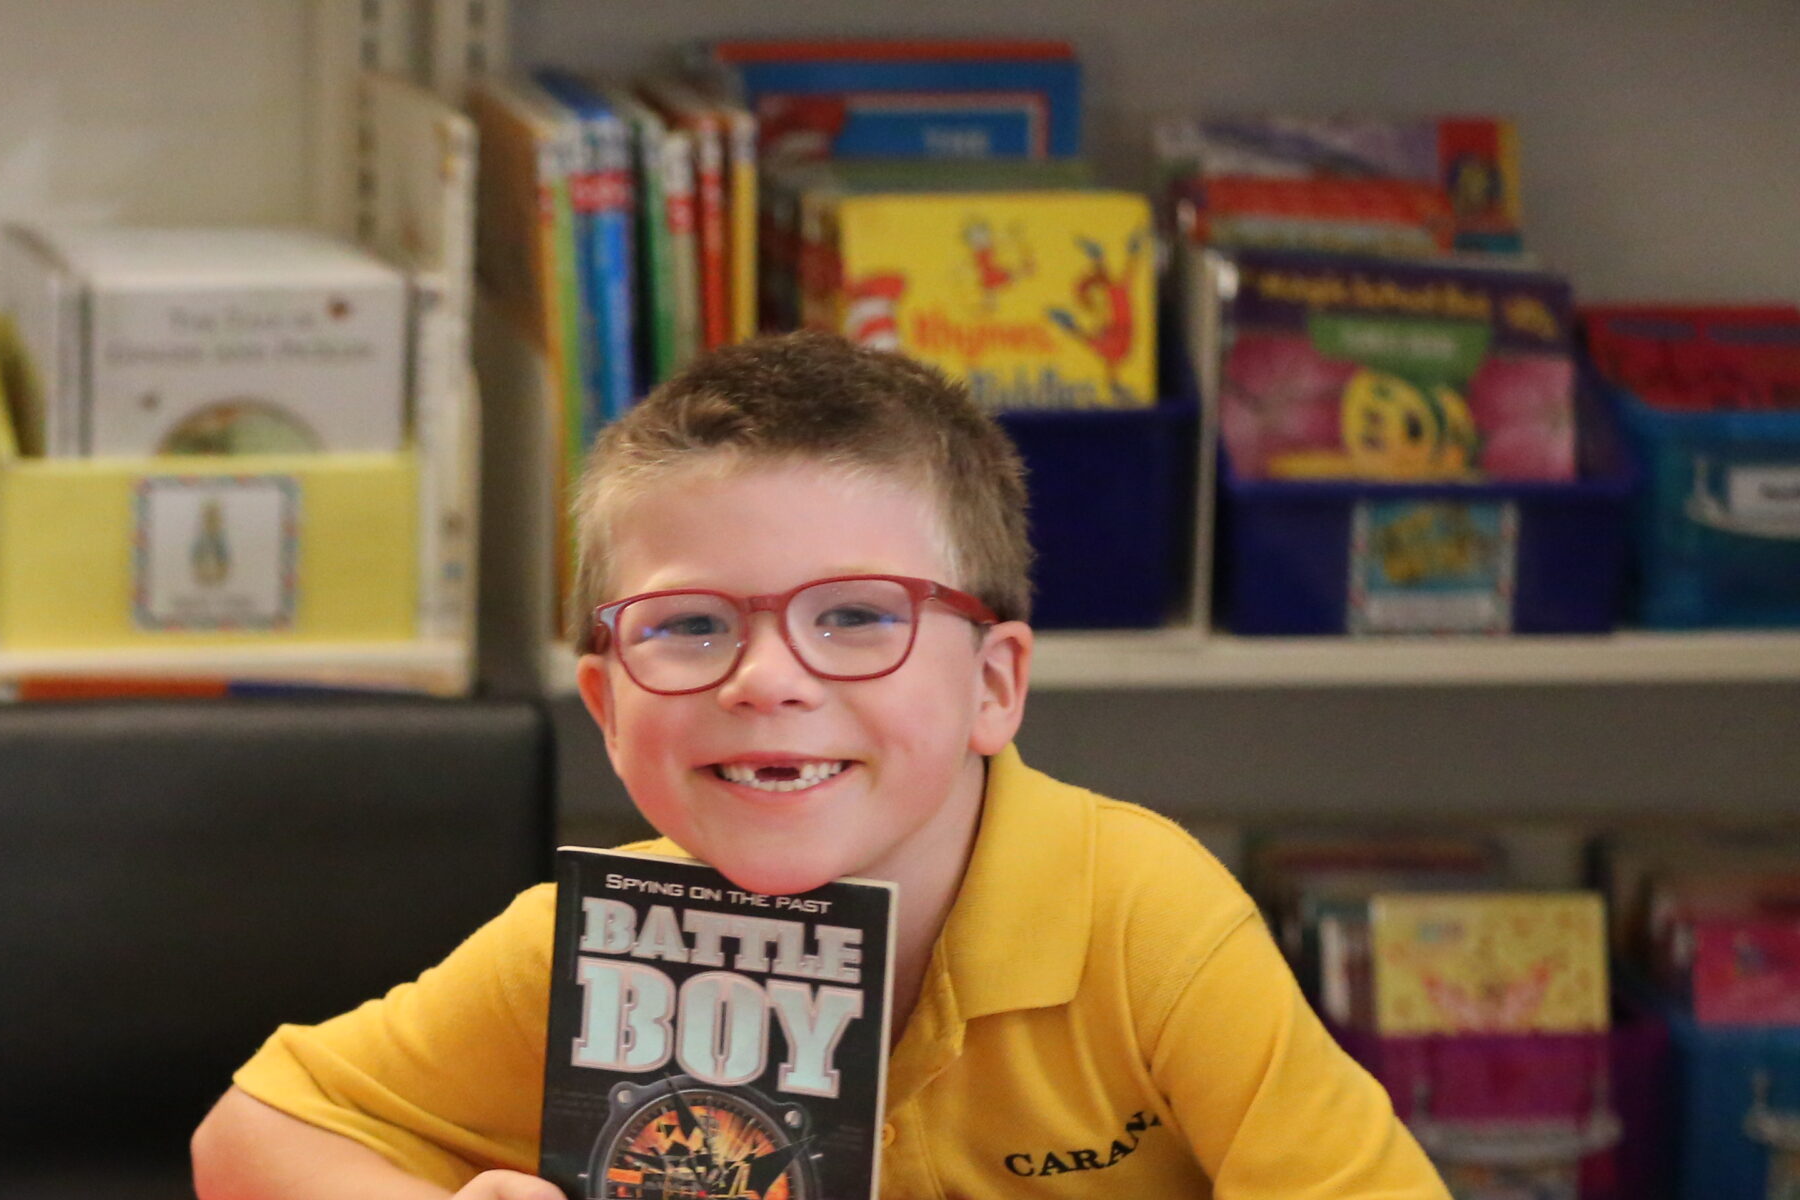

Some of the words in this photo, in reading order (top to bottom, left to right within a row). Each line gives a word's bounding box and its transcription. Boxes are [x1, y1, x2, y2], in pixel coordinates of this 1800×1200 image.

[604, 873, 686, 898] SPYING
[689, 886, 722, 902] ON
[727, 891, 770, 908] THE
[775, 896, 833, 914] PAST
[580, 896, 863, 984] BATTLE
[571, 958, 864, 1098] BOY
